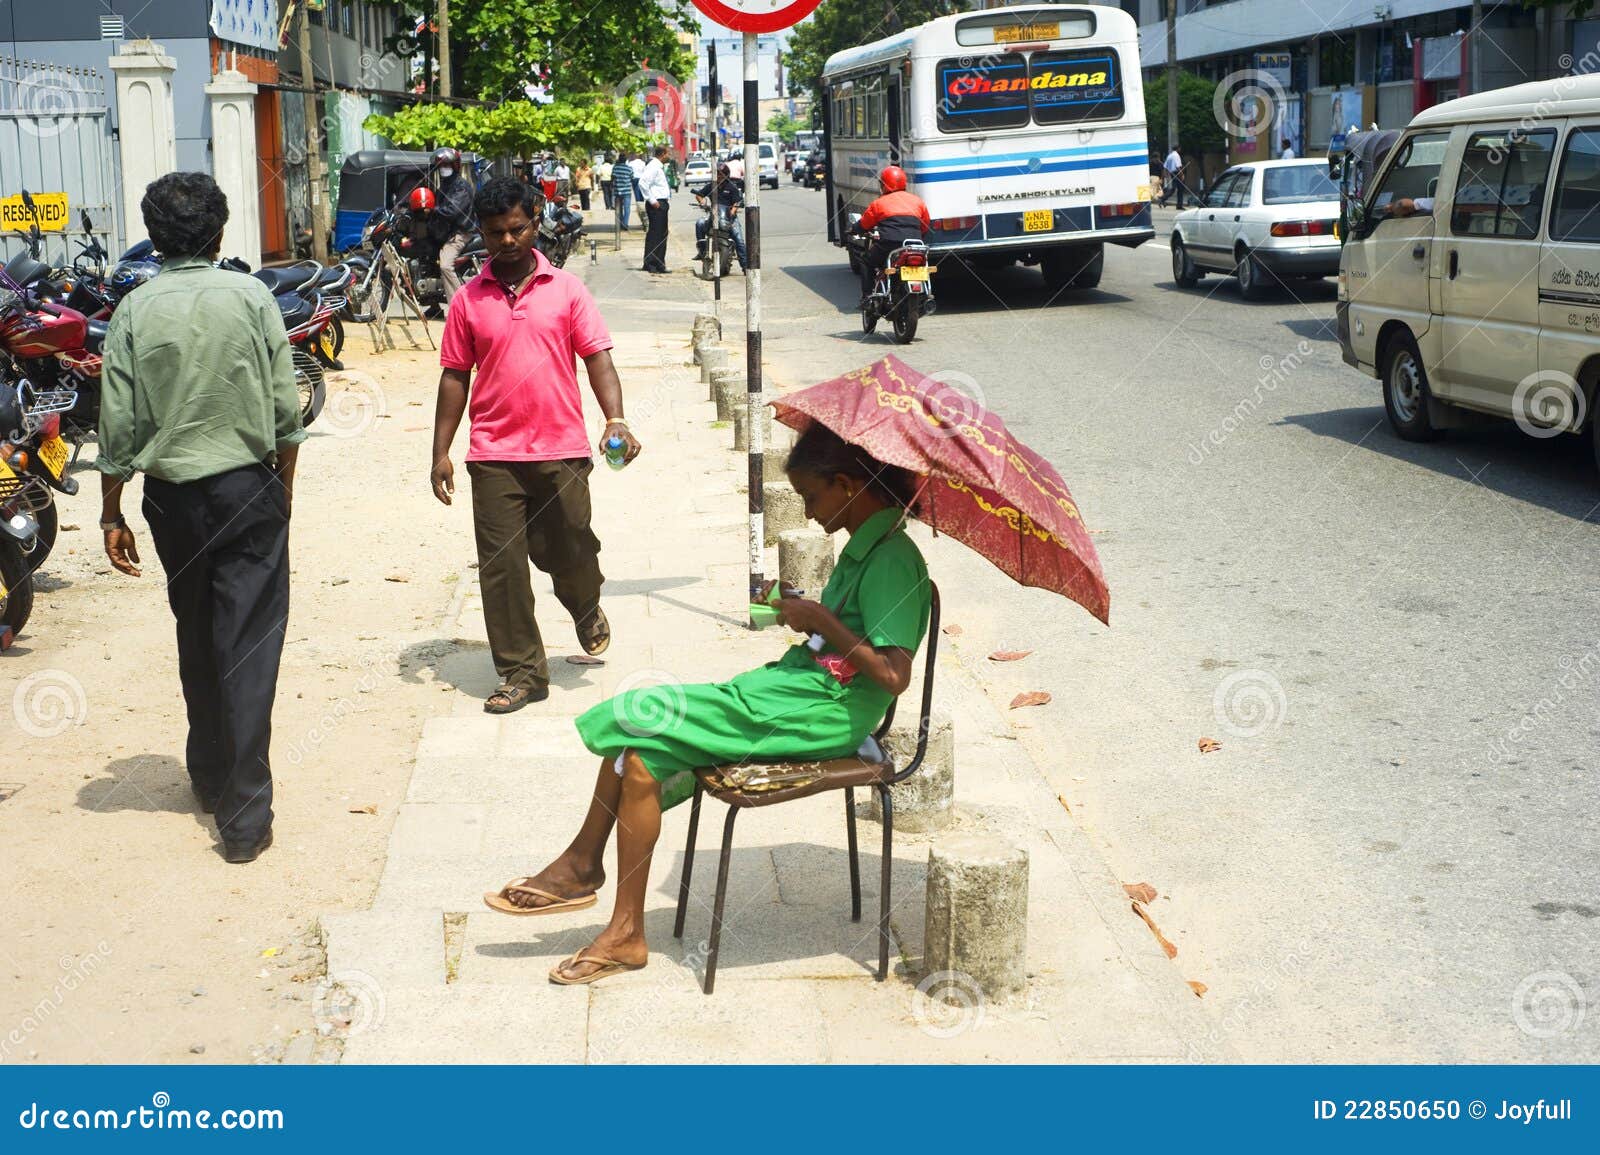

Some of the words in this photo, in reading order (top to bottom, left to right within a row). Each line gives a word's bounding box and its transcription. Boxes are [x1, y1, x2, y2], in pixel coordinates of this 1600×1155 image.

[948, 71, 1107, 96] Chandana
[1033, 92, 1080, 103] Super
[977, 193, 1012, 201] LANKA
[1014, 190, 1047, 200] ASHOK
[1049, 186, 1096, 197] LEYLAND
[3, 204, 60, 222] RESERVED
[1028, 220, 1049, 230] 6538
